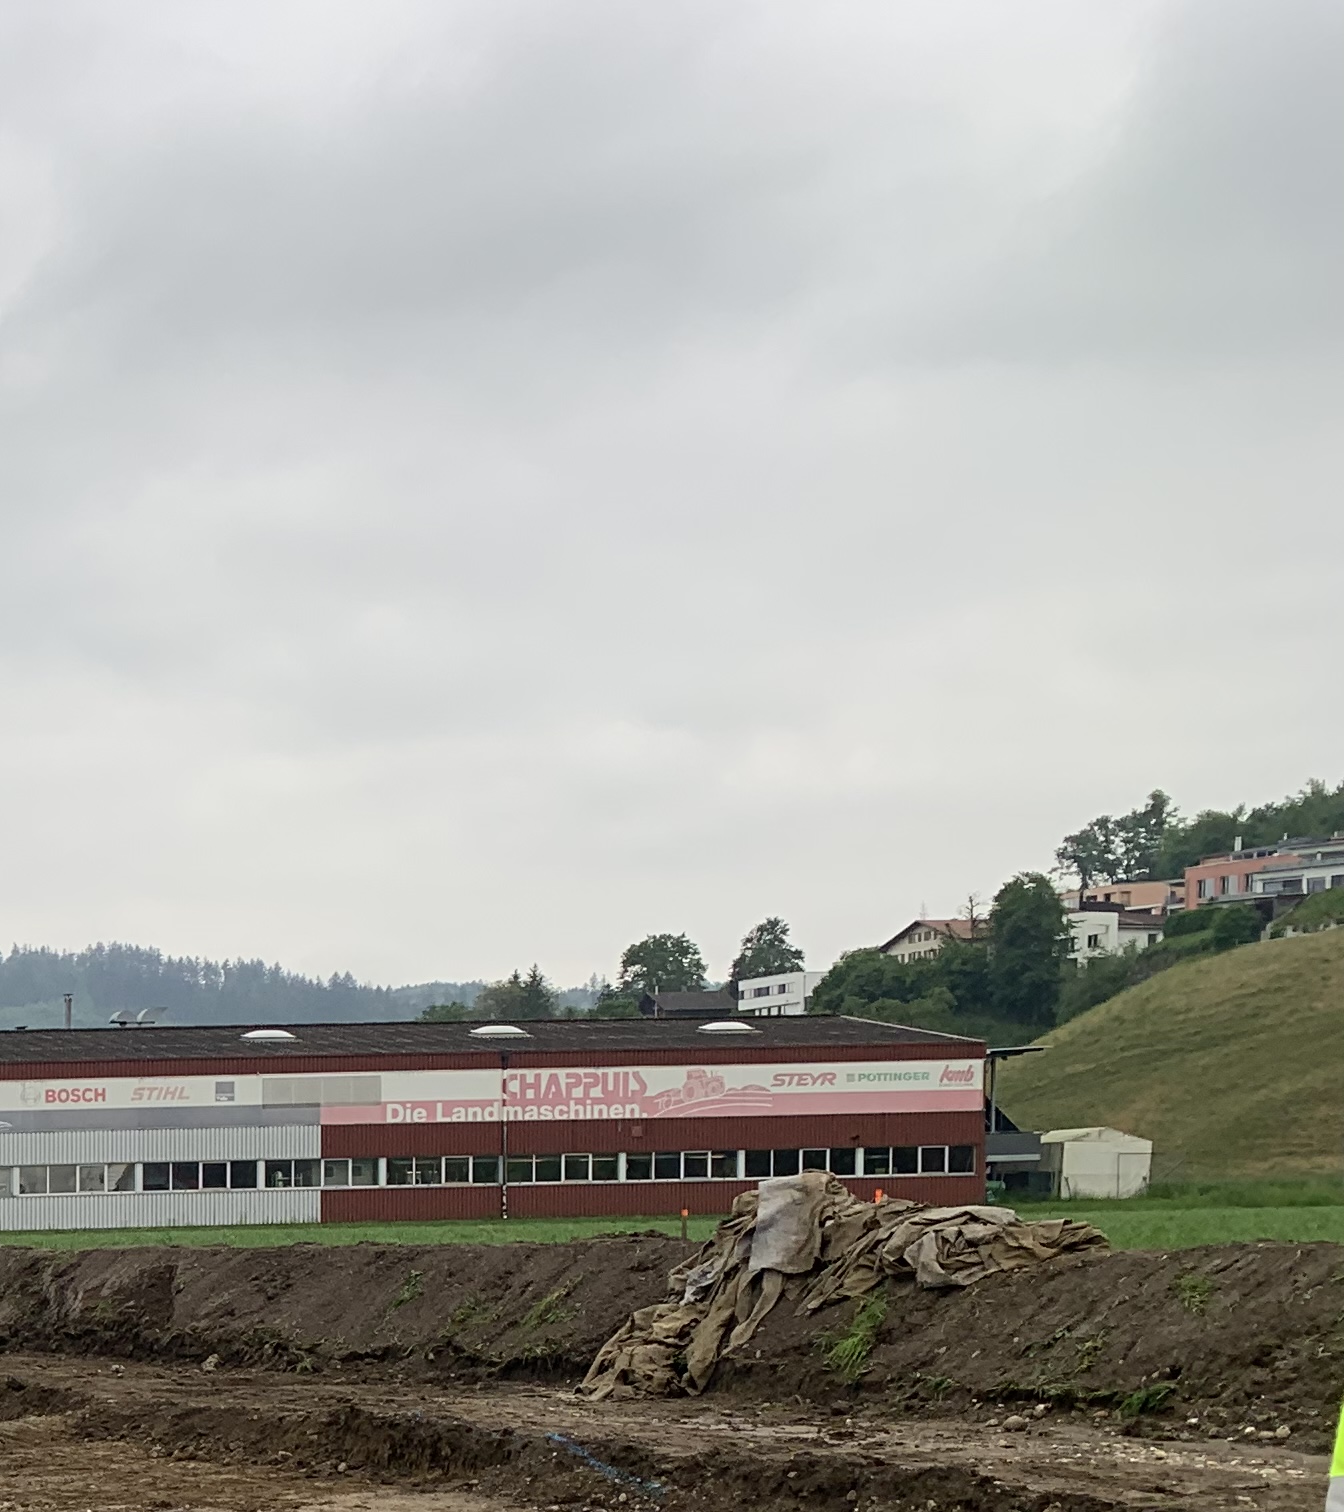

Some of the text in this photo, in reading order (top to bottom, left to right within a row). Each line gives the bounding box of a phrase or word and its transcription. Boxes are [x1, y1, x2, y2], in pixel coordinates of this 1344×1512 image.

[502, 1070, 649, 1100] CHAPPUIS
[770, 1072, 838, 1088] STEYR
[45, 1086, 190, 1104] BOSCH STIHL
[385, 1099, 649, 1123] Die Landmaschinen.
